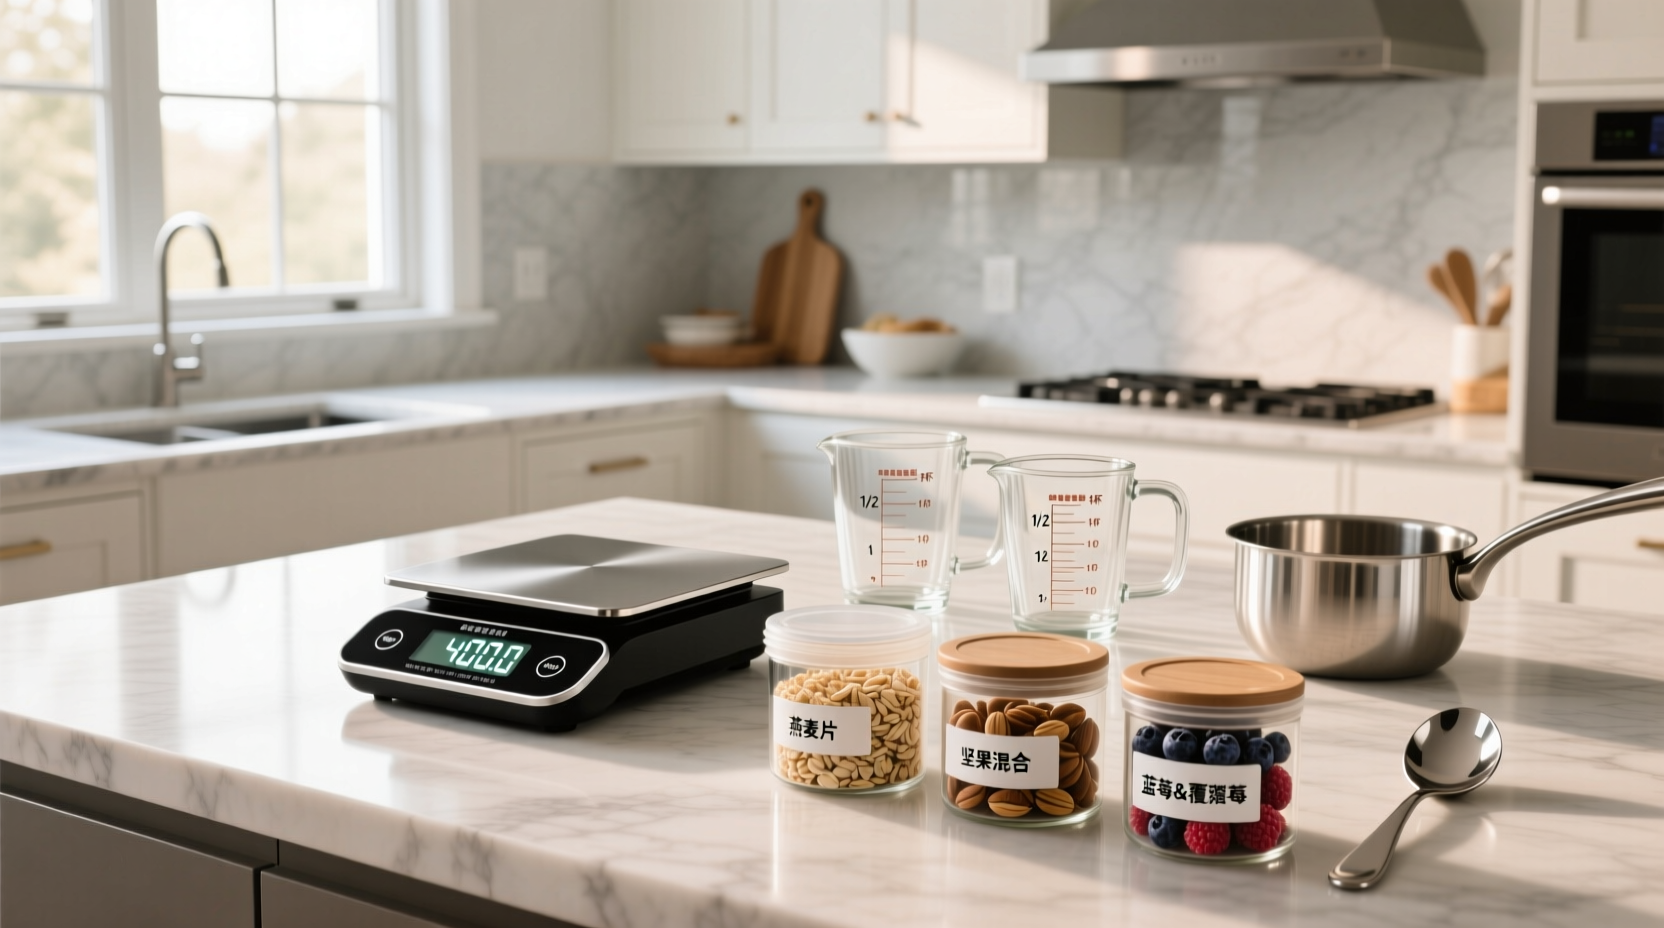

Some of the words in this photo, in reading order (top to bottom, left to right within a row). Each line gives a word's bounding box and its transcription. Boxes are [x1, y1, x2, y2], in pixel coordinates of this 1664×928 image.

[860, 495, 879, 509] 1/2
[1032, 513, 1050, 528] 1/2
[1035, 550, 1048, 563] 12
[446, 637, 524, 675] 400.0
[789, 716, 837, 741] 燕麦片
[961, 746, 1031, 773] 坚果混合
